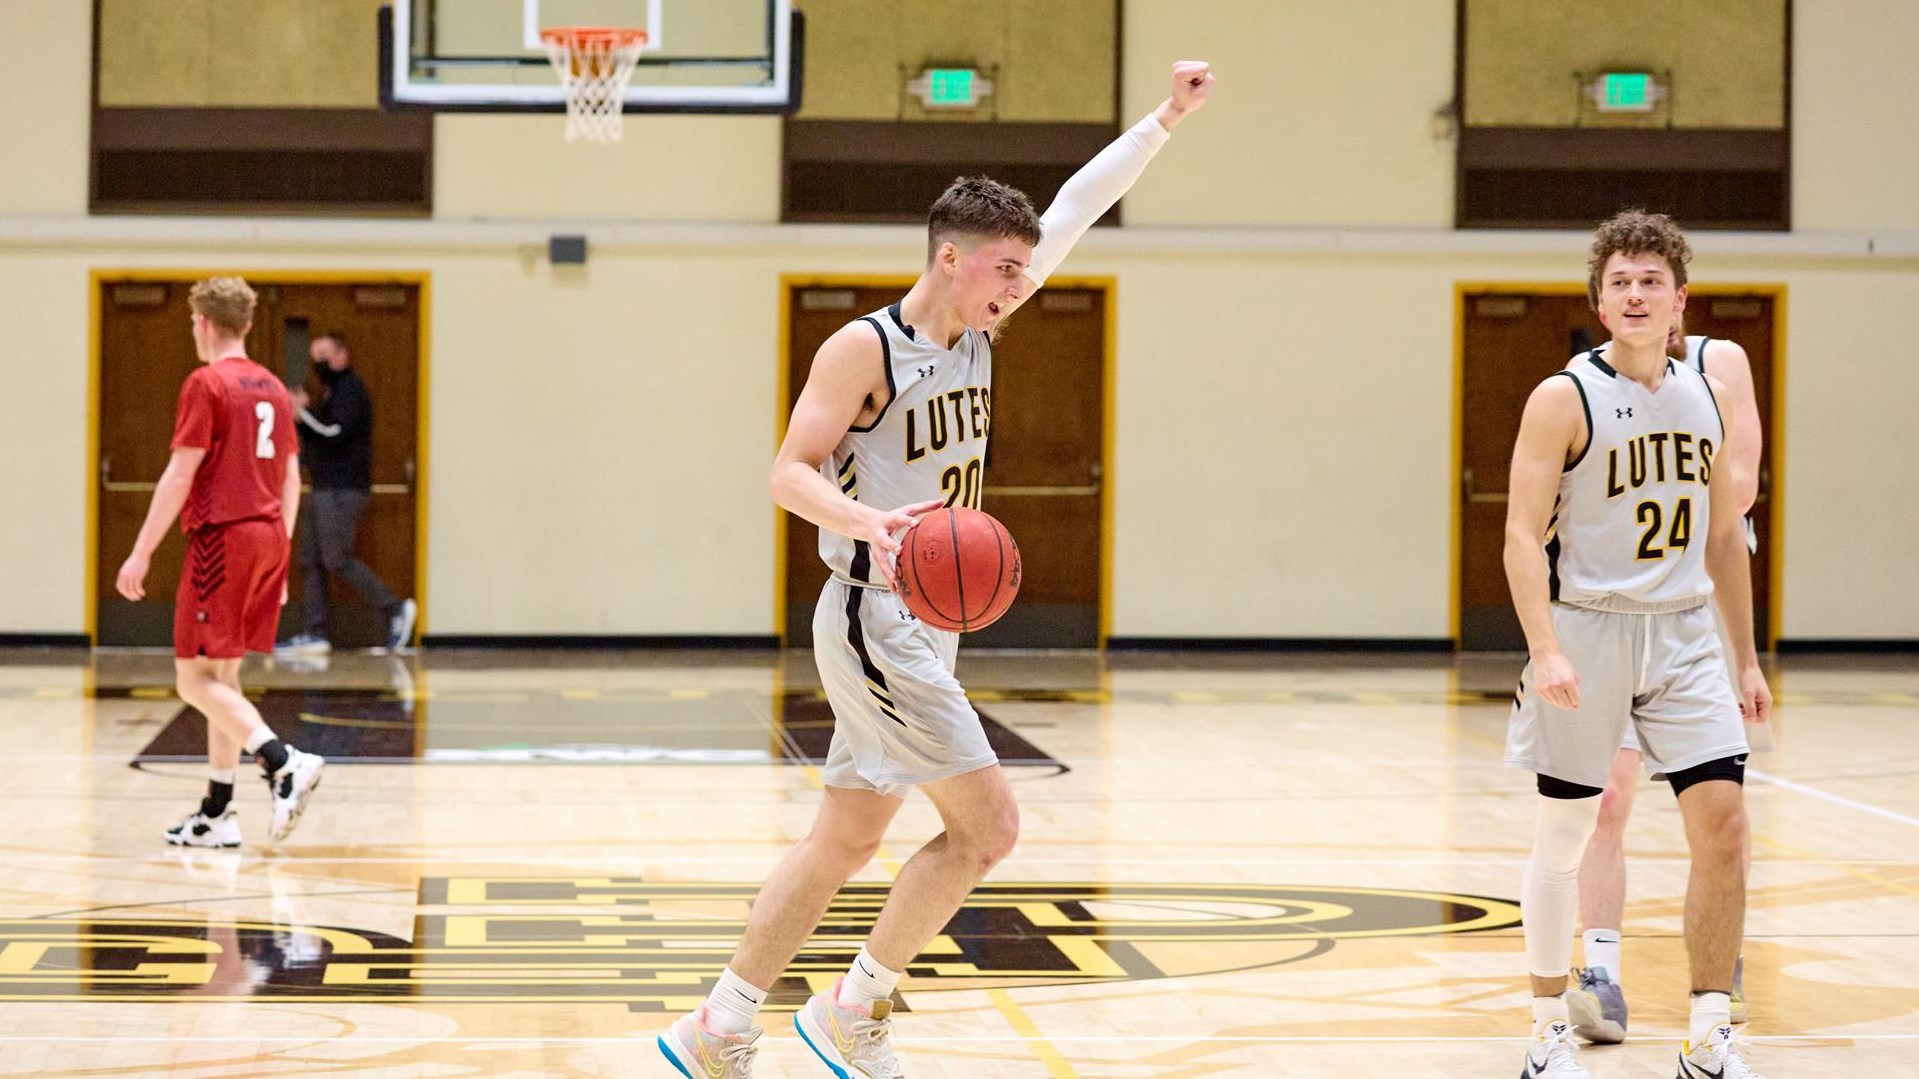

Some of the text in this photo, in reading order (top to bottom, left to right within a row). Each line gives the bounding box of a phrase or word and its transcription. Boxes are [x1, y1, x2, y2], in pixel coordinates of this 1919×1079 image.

[254, 401, 276, 459] 2
[905, 386, 990, 464] LUTES
[941, 457, 981, 509] 20
[1606, 431, 1713, 498] LUTES
[1635, 496, 1692, 561] 24
